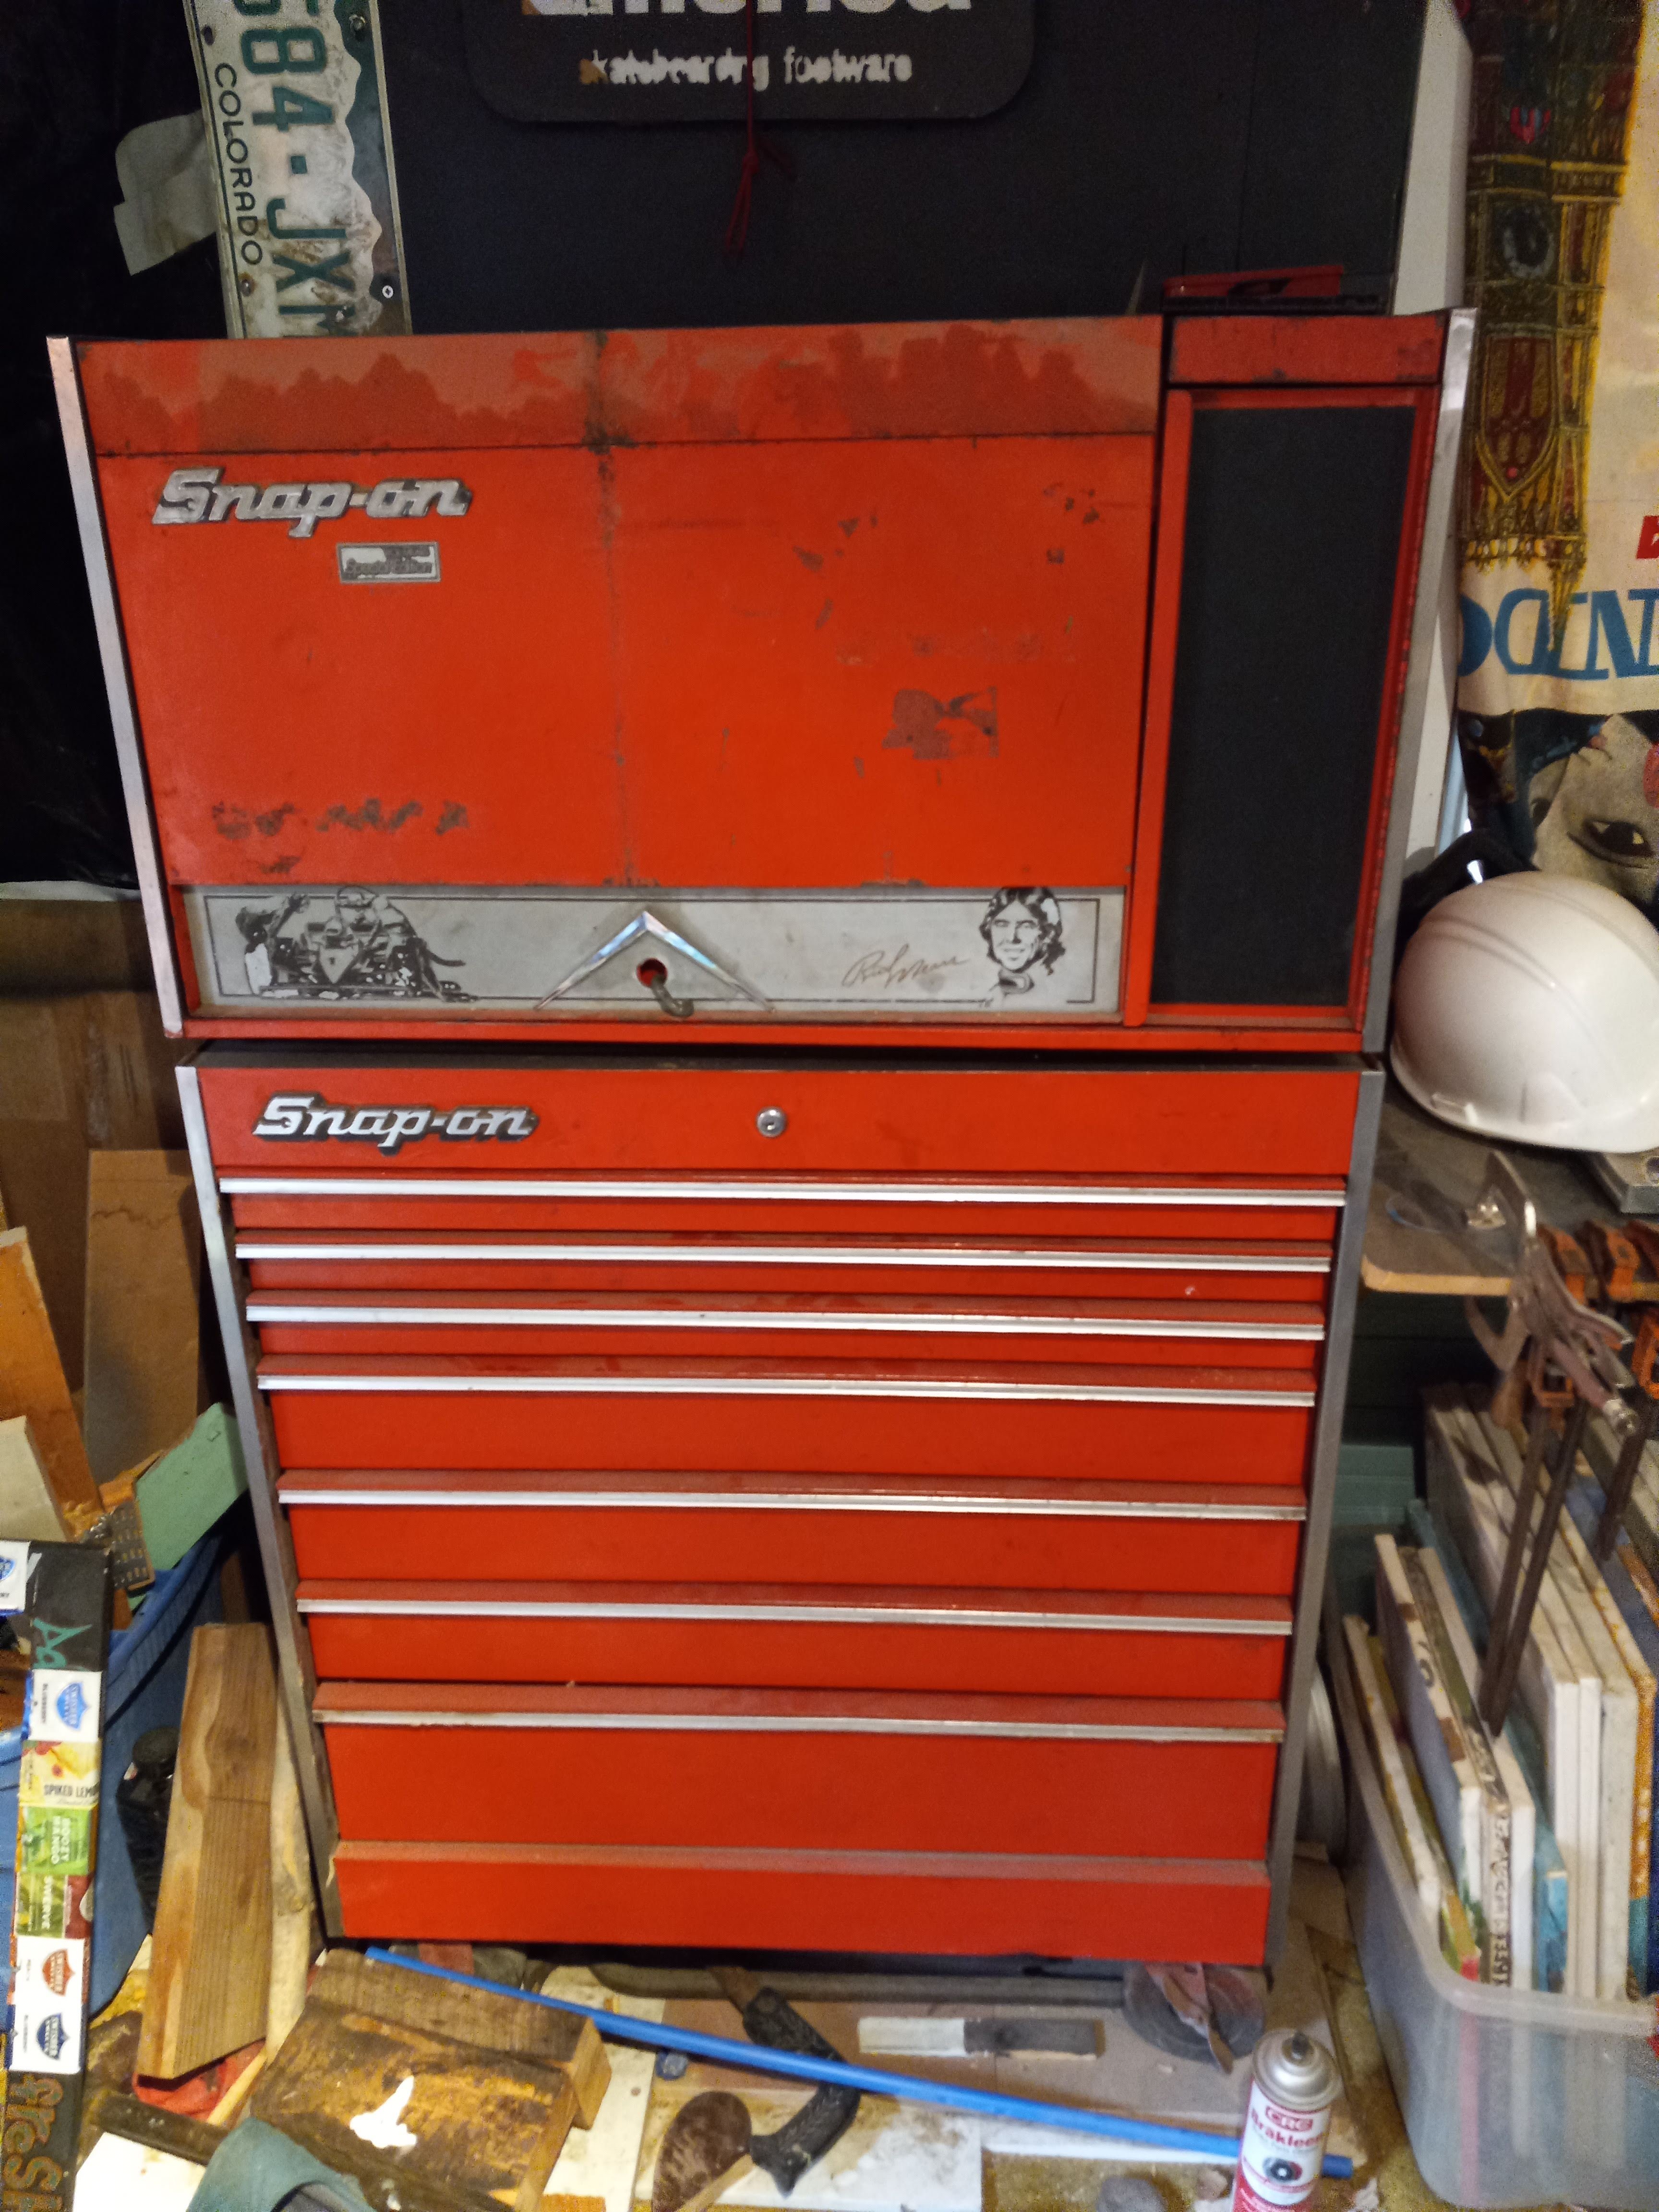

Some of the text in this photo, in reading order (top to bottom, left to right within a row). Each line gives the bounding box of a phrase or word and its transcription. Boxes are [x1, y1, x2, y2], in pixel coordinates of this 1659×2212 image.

[214, 62, 263, 265] COLORADO
[152, 466, 472, 538] Snap-on
[252, 1092, 536, 1154] Snap-on
[42, 1875, 53, 1929] SWERVE
